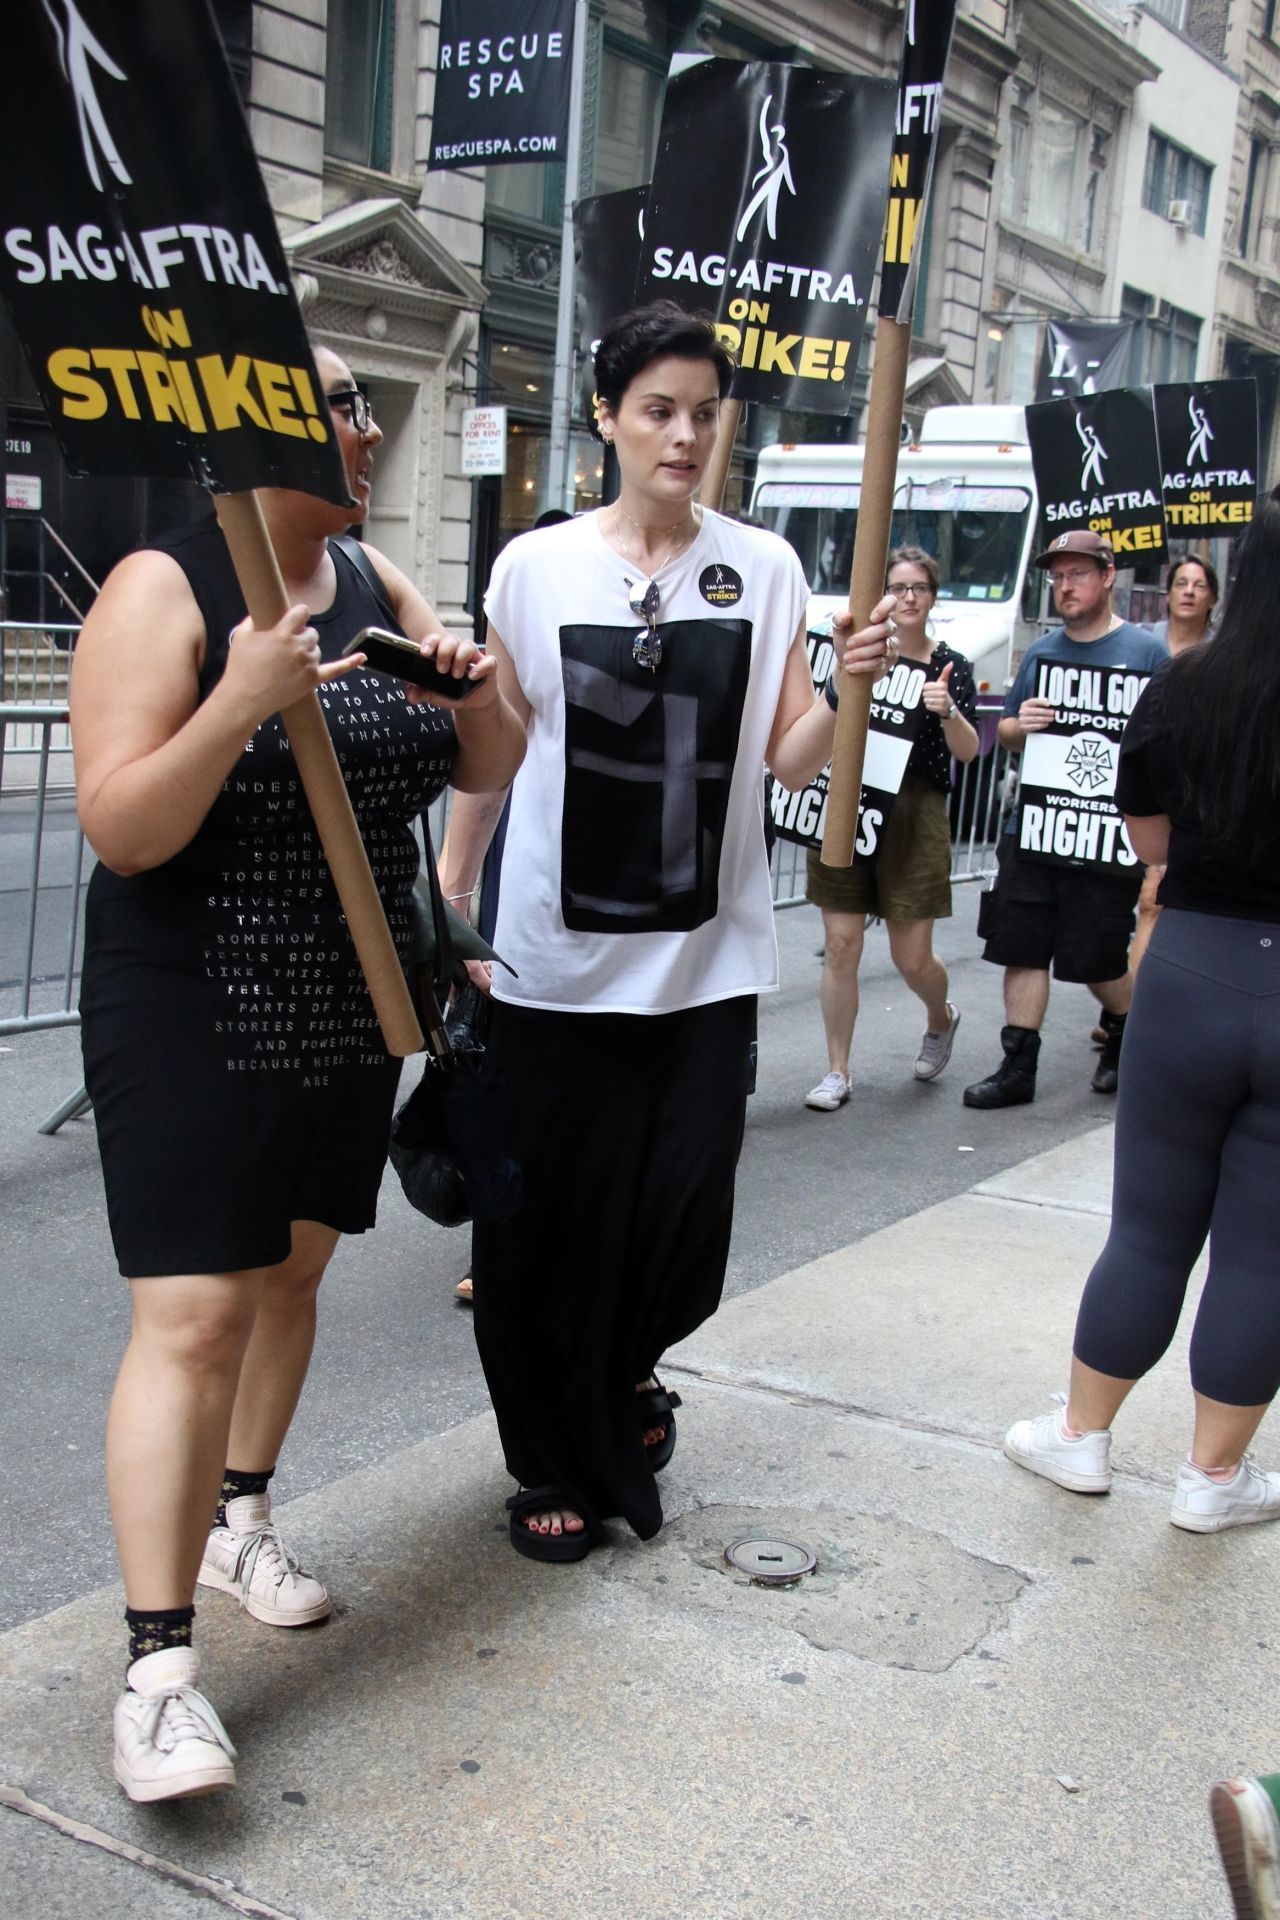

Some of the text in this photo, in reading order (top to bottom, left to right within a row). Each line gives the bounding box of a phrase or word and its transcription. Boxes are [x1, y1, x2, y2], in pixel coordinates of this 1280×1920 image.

[440, 33, 562, 69] RESCUE
[468, 69, 524, 99] SPA
[435, 136, 557, 160] RESCUESPA.COM
[728, 298, 770, 324] ON
[141, 305, 192, 349] ON
[47, 348, 328, 444] STRIKE!
[465, 430, 501, 439] FOR RENT
[1189, 491, 1212, 503] ON
[1088, 517, 1113, 533] ON
[360, 678, 379, 689] TO
[1038, 664, 1103, 712] LOCAL
[344, 697, 362, 708] TO
[420, 719, 449, 734] ALL
[376, 742, 419, 758] THAT
[268, 800, 296, 811] WE
[364, 779, 409, 794] WHEN
[237, 914, 291, 925] THAT
[313, 914, 321, 925] I
[289, 951, 339, 962] GOOD
[206, 966, 254, 978] LIKE
[227, 984, 274, 996] FEEL
[291, 985, 335, 995] LIKE
[240, 1002, 297, 1013] PARTS
[312, 1002, 331, 1013] OF
[215, 1021, 294, 1032] STORIES
[309, 1021, 343, 1032] FEEL
[254, 1039, 287, 1052] AND
[227, 1058, 301, 1071] BECAUSE
[303, 1075, 329, 1088] ARE
